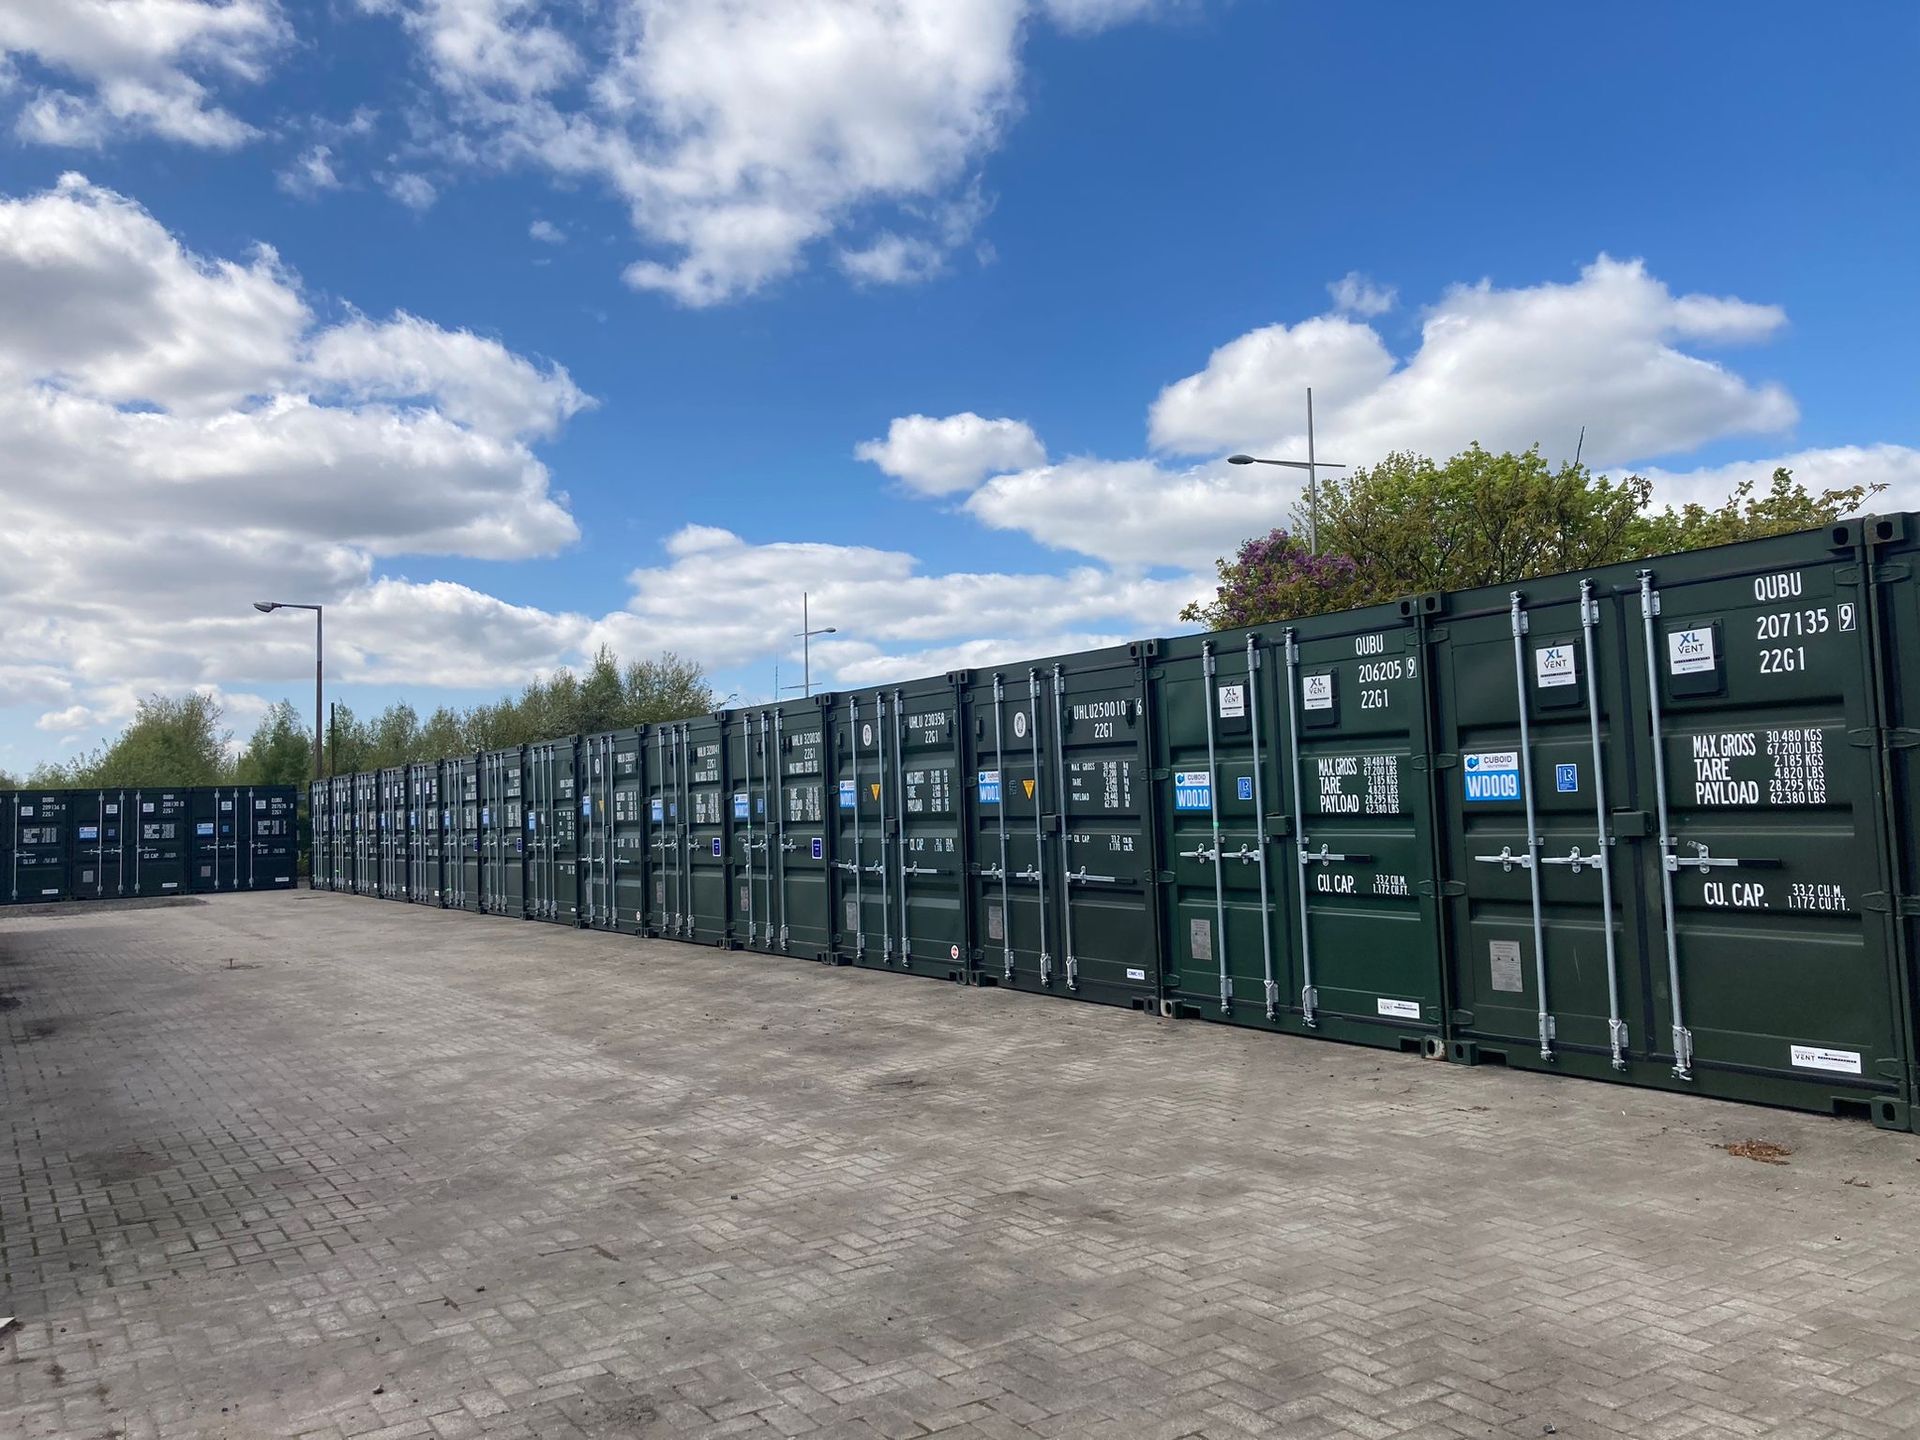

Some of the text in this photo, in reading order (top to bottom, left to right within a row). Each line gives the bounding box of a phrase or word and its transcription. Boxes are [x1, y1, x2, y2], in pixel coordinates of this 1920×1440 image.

[1754, 572, 1802, 600] QUBU
[1756, 605, 1852, 640] 207135 9
[1355, 634, 1384, 656] QUBU
[1680, 632, 1699, 646] XL
[1546, 649, 1563, 662] XL
[1678, 643, 1704, 654] VENT
[1544, 660, 1567, 669] VENT
[1759, 646, 1805, 673] 22G1
[1359, 658, 1415, 683] 206205 9
[1310, 678, 1323, 688] XL
[1225, 688, 1237, 698] XL
[1361, 689, 1388, 709] 22G1
[1094, 722, 1112, 738] 22G1
[1693, 729, 1822, 757] MAX. GROSS 30.480 KGS
[1767, 742, 1823, 755] 67.200 LBS
[1335, 757, 1357, 776] GROSS
[1484, 755, 1512, 764] CUBOID
[1694, 754, 1824, 781] TARE 2.185 KGS
[1775, 767, 1825, 779] 4.820 LBS
[1319, 776, 1342, 794] TARE
[1467, 773, 1517, 797] WD009
[1696, 779, 1826, 804] PAYLOAD 28.295 KGS
[1176, 789, 1209, 807] WD010
[1320, 794, 1360, 813] PAYLOAD
[1771, 791, 1826, 804] 62.380 LBS
[1317, 874, 1333, 892] CU.
[1334, 875, 1357, 894] CAP.
[1704, 882, 1729, 906] CU.
[1732, 883, 1769, 907] CAP.
[1792, 883, 1815, 896] 33.2
[1788, 895, 1816, 909] 1.172
[1795, 1053, 1815, 1061] VENT
